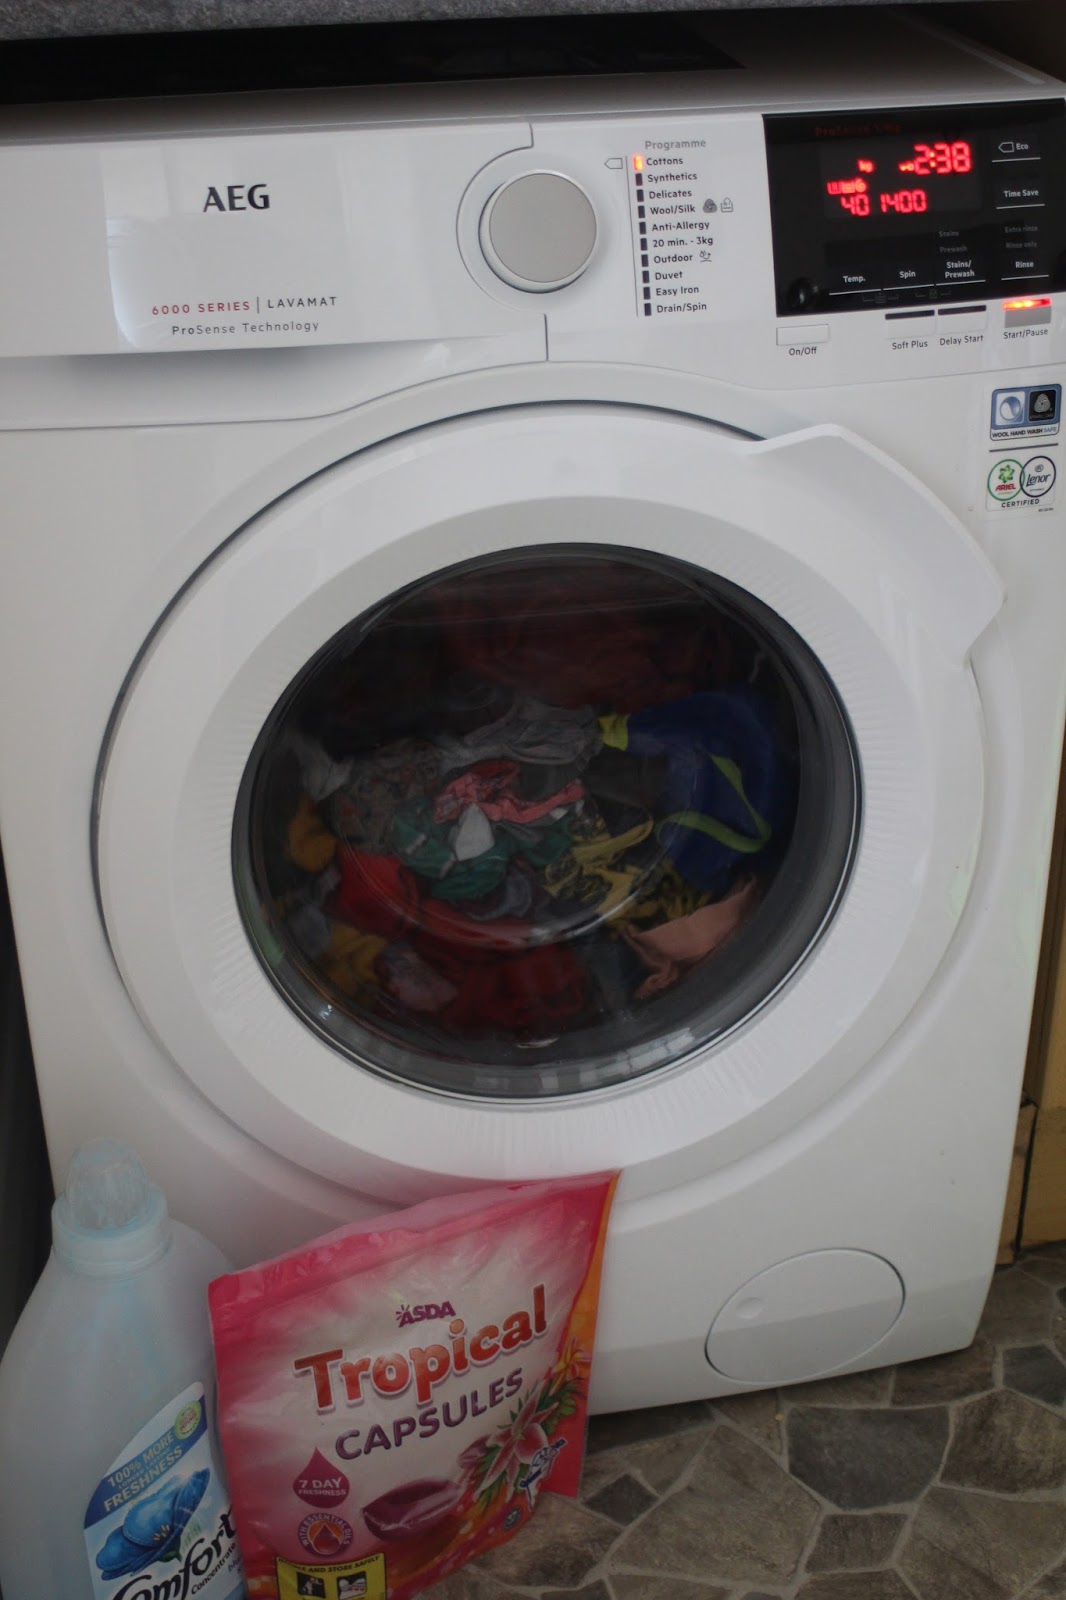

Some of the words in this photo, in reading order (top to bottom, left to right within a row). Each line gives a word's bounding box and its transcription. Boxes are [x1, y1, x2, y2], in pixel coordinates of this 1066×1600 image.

[644, 140, 707, 151] Programme
[1016, 142, 1029, 151] Eco
[646, 157, 683, 166] Cottons
[914, 141, 972, 175] 2:38
[647, 172, 698, 183] Synthetics
[203, 183, 270, 213] AEG
[649, 189, 692, 199] Delicates
[1003, 189, 1020, 197] Time
[1022, 188, 1039, 197] Save
[841, 194, 871, 216] 40
[880, 189, 927, 213] 1400
[650, 205, 696, 215] Wool/Silk
[651, 221, 710, 232] Anti-Allergy
[939, 229, 959, 238] Stains
[652, 239, 664, 248] 20
[668, 237, 688, 247] min.
[696, 236, 713, 247] 3kg
[939, 245, 968, 253] Prewash
[653, 254, 693, 264] Outdoor
[1015, 260, 1034, 269] Rinse
[946, 260, 972, 270] Stains/
[655, 271, 683, 281] Duvet
[843, 275, 866, 284] Temp.
[899, 269, 916, 279] Spin
[944, 269, 975, 279] Prewash
[656, 287, 678, 297] Easy
[680, 286, 699, 294] Iron
[267, 296, 337, 309] LAVAMAT
[656, 302, 707, 313] Drain/Spin
[151, 304, 190, 316] 6000
[198, 301, 250, 313] SERIES
[171, 325, 236, 336] ProSense
[242, 320, 319, 334] Technology
[1003, 328, 1049, 340] Start/Pause
[892, 341, 909, 350] Soft
[911, 340, 928, 349] Plus
[939, 336, 962, 347] Delay
[964, 334, 984, 344] Start
[788, 346, 817, 357] On/Off
[1010, 429, 1026, 437] HAND
[1043, 426, 1057, 434] SAFE
[1026, 473, 1051, 488] Lenor
[995, 483, 1016, 491] ARIEL
[1001, 498, 1040, 508] CERTIFIED
[396, 1301, 456, 1328] ASDA
[293, 1283, 549, 1413] Tropical
[335, 1367, 524, 1460] CAPSULES
[107, 1461, 142, 1487] 100%
[142, 1432, 175, 1464] MORE
[103, 1445, 183, 1512] FRESHNESS
[298, 1479, 308, 1489] 7
[312, 1477, 342, 1489] DAY
[298, 1488, 347, 1497] FRESHNESS
[303, 1513, 348, 1529] ESSENTIAL
[191, 1543, 236, 1595] Concentrate
[327, 1564, 353, 1573] STORE
